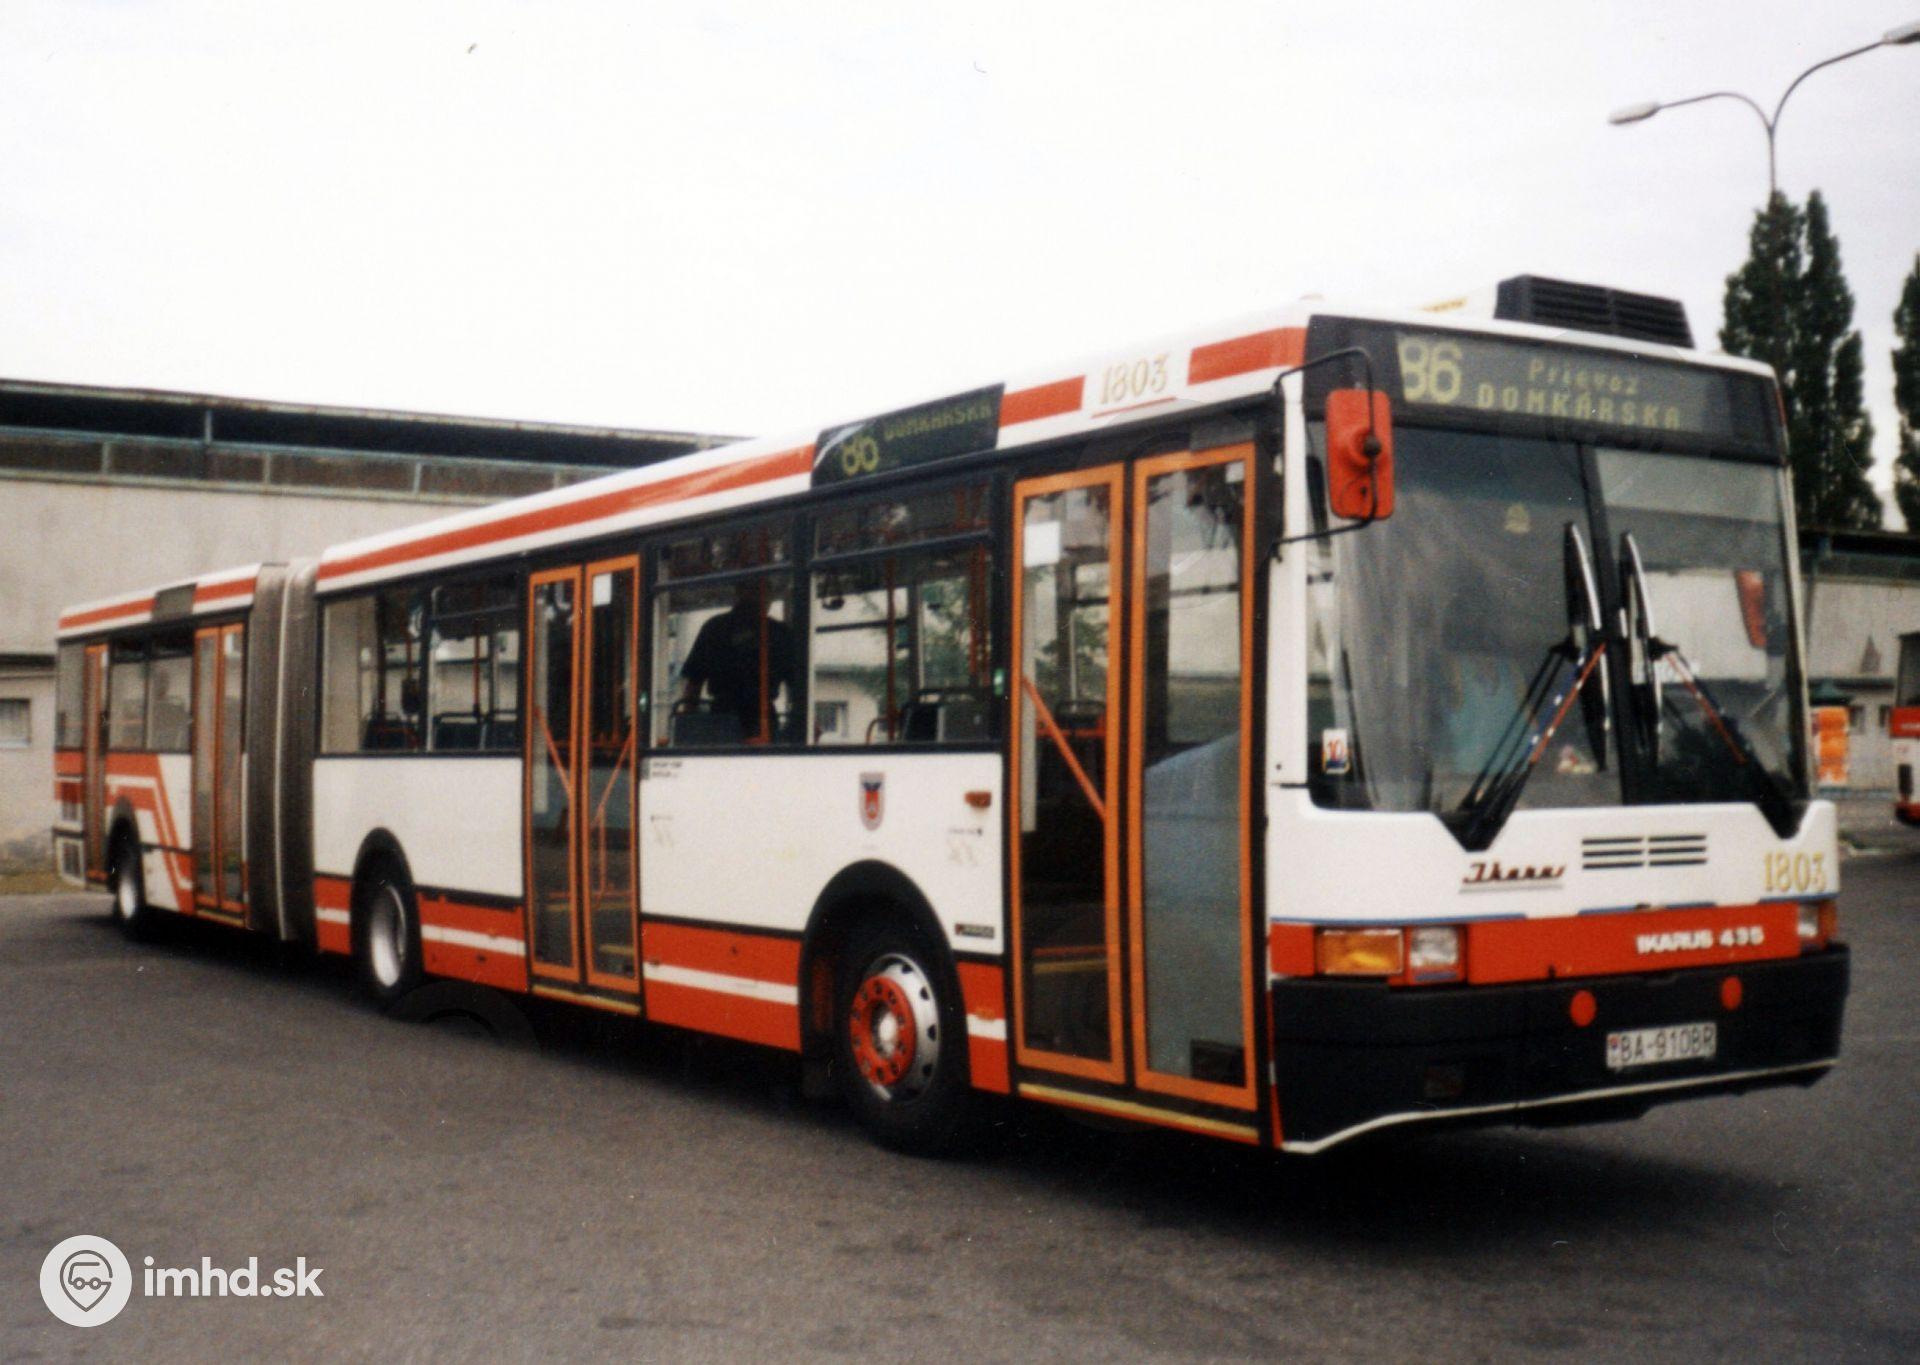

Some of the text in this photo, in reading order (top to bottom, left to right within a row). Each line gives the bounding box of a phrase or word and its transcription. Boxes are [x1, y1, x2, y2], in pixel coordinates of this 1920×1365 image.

[1100, 355, 1169, 404] 1803
[1398, 337, 1463, 404] 86
[1763, 852, 1827, 892] 1803
[1635, 926, 1765, 955] IKARUS 435
